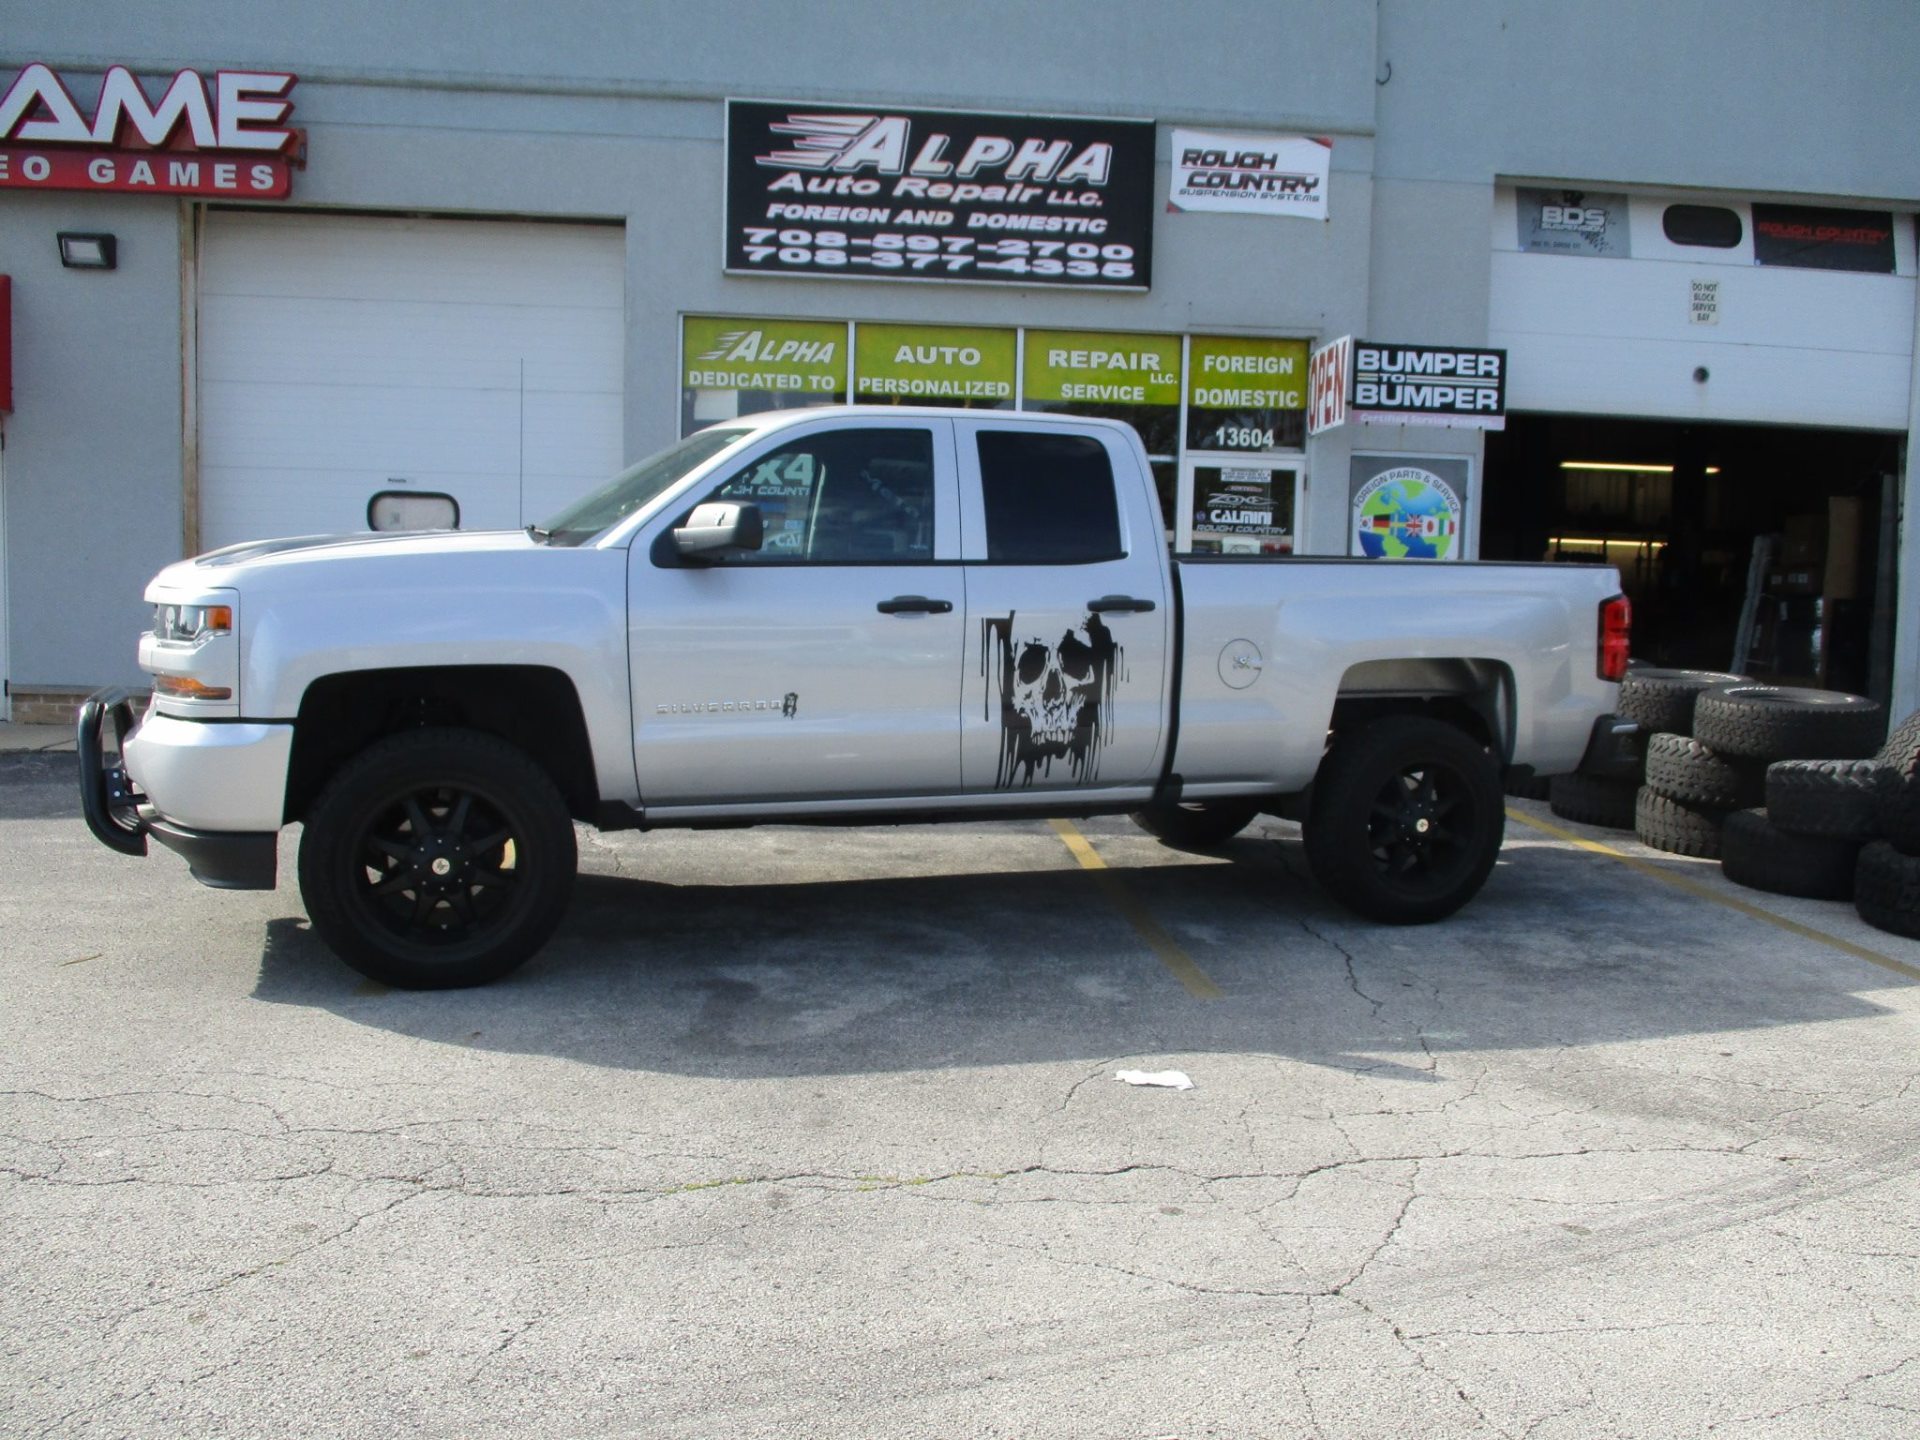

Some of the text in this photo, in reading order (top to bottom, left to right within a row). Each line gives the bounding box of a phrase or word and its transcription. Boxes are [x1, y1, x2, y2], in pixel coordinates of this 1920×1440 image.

[833, 117, 1112, 185] ALPHA
[1181, 149, 1278, 169] ROUGH
[88, 159, 274, 190] GAMES
[1187, 171, 1319, 193] COUNTRY
[768, 172, 881, 196] Auto
[892, 178, 1043, 204] Repair
[1178, 187, 1321, 202] SUSPENSION SYSTEMS
[766, 204, 1108, 234] FOREIGN AND DOMESTIC
[1541, 206, 1605, 226] BDS
[743, 227, 1134, 260] 708-597-2700
[743, 245, 1135, 279] 708-377-4335
[1692, 283, 1717, 292] DO NOT
[1693, 292, 1715, 301] BLOCK
[1692, 302, 1716, 312] SERVICE
[727, 330, 835, 363] ALPHA
[894, 345, 981, 365] AUTO
[1049, 349, 1177, 384] REPAIR LLC.
[1203, 355, 1293, 374] FOREIGN
[1357, 349, 1500, 377] BUMPER
[689, 371, 835, 390] DEDICATED TO
[859, 377, 1010, 396] PERSONALIZED
[1308, 341, 1347, 432] OPEN
[1380, 373, 1405, 383] TO
[1061, 383, 1145, 400] SERVICE
[1194, 388, 1298, 408] DOMESTIC
[1356, 383, 1498, 411] BUMPER
[1216, 426, 1275, 448] 13604
[1353, 475, 1388, 508] FOREIGN
[1389, 470, 1422, 482] PARTS
[1432, 479, 1460, 515] SERVICE
[1210, 509, 1272, 525] CALMINI
[1196, 524, 1286, 535] ROUGH COUNTRY
